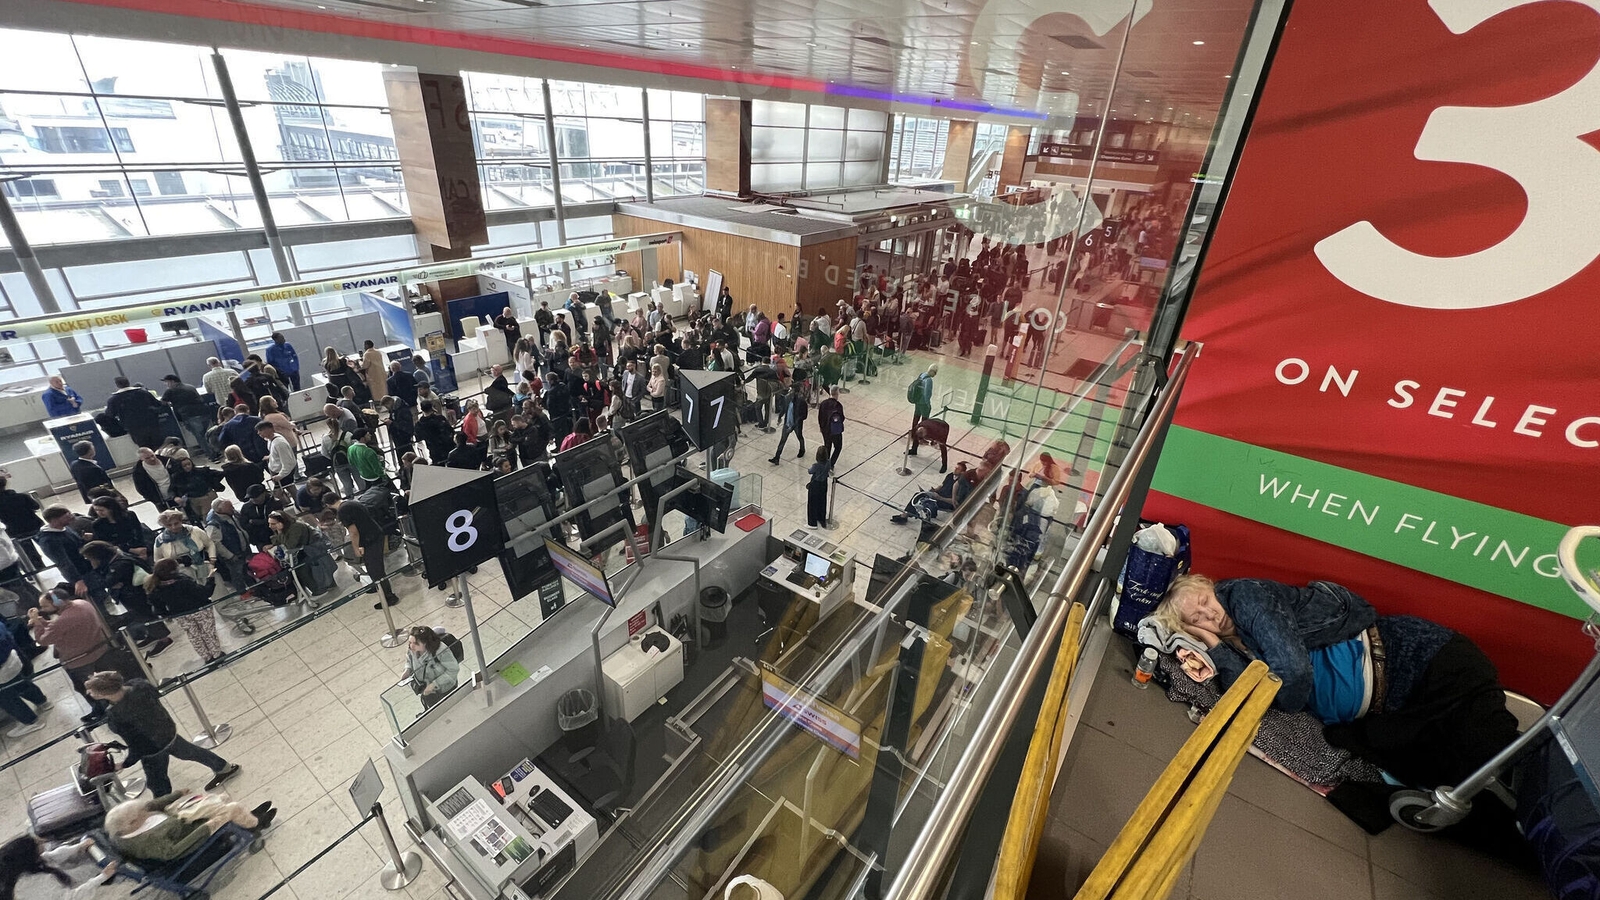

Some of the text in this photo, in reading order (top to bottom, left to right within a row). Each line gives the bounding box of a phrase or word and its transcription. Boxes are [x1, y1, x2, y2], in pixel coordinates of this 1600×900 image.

[1084, 234, 1093, 246] 6
[1104, 226, 1113, 237] 5
[342, 275, 398, 290] RYANAIR
[261, 287, 317, 302] TICKET DESK
[164, 298, 242, 316] RYANAIR
[46, 313, 129, 334] TICKET DESK
[685, 393, 694, 424] 7
[710, 395, 725, 429] 7
[1275, 357, 1600, 448] ON SELEC
[445, 509, 478, 552] 8
[1259, 474, 1561, 578] WHEN FLYING
